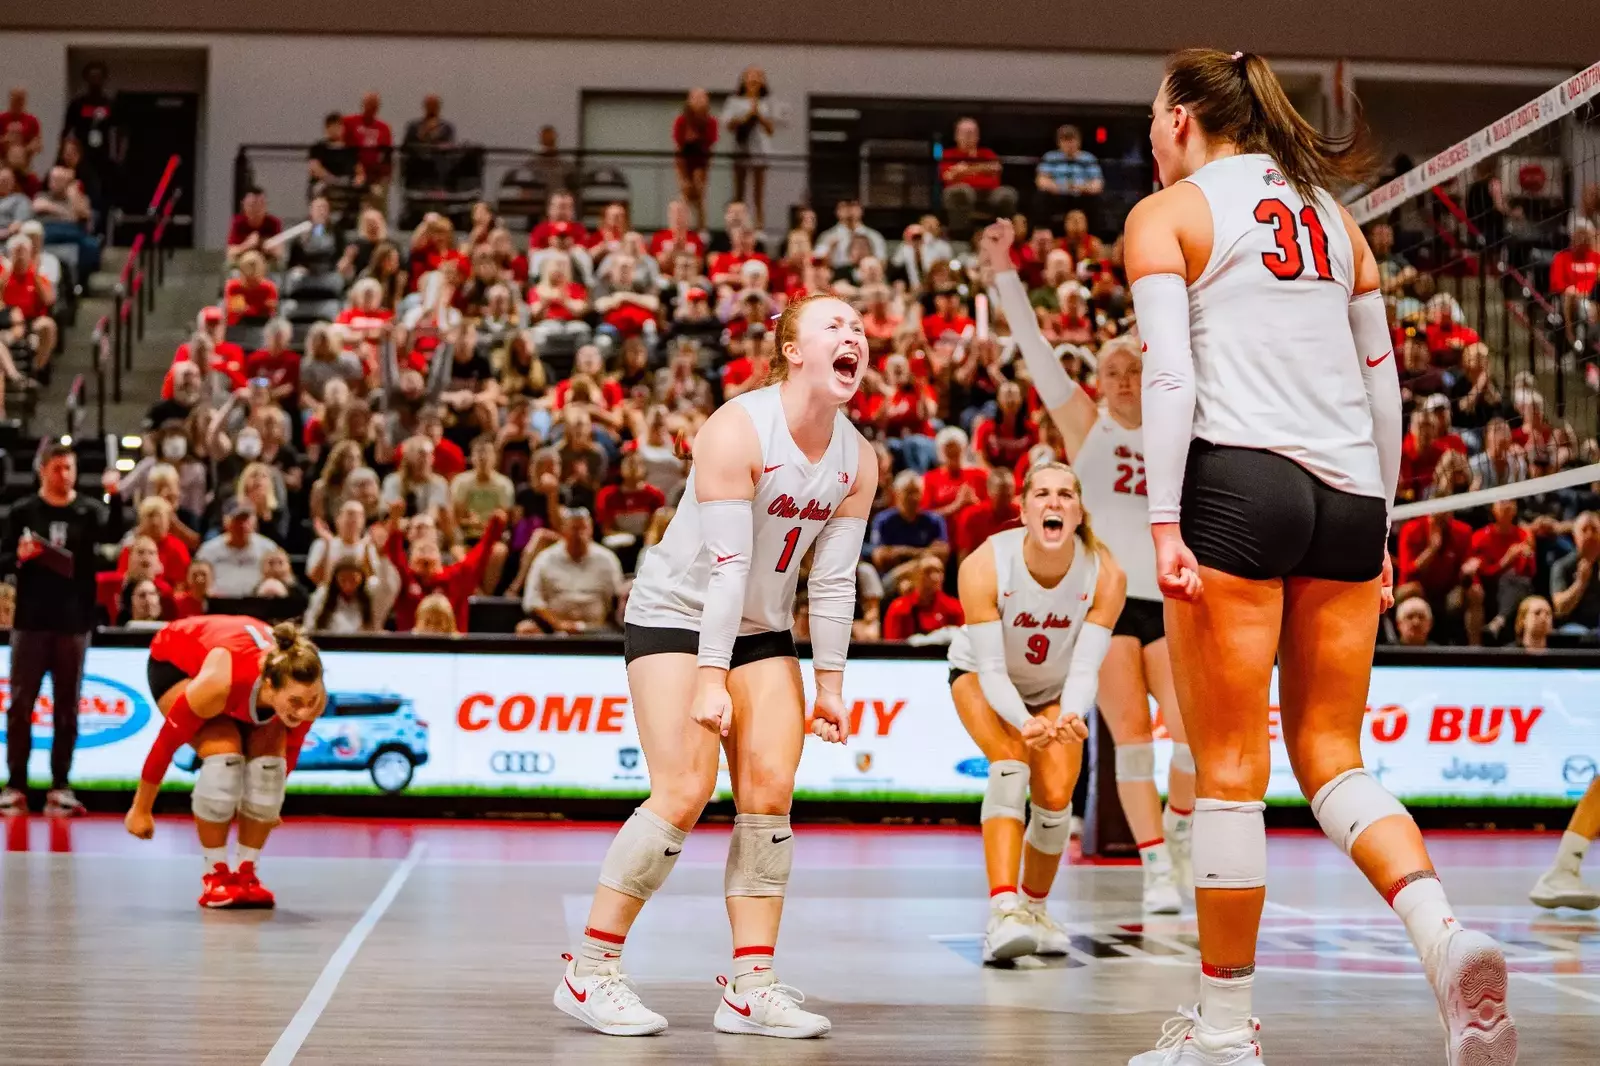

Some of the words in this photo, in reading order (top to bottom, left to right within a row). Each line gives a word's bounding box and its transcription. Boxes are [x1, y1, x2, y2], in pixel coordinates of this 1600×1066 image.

[1253, 197, 1336, 281] 31
[1113, 463, 1148, 497] 22
[767, 493, 799, 518] Ohio
[799, 498, 832, 521] State
[775, 526, 802, 573] 1
[1013, 611, 1040, 628] Ohio
[1042, 611, 1072, 629] State
[1024, 633, 1051, 665] 9
[456, 693, 628, 732] COME
[1365, 705, 1408, 743] O
[1428, 706, 1544, 743] BUY
